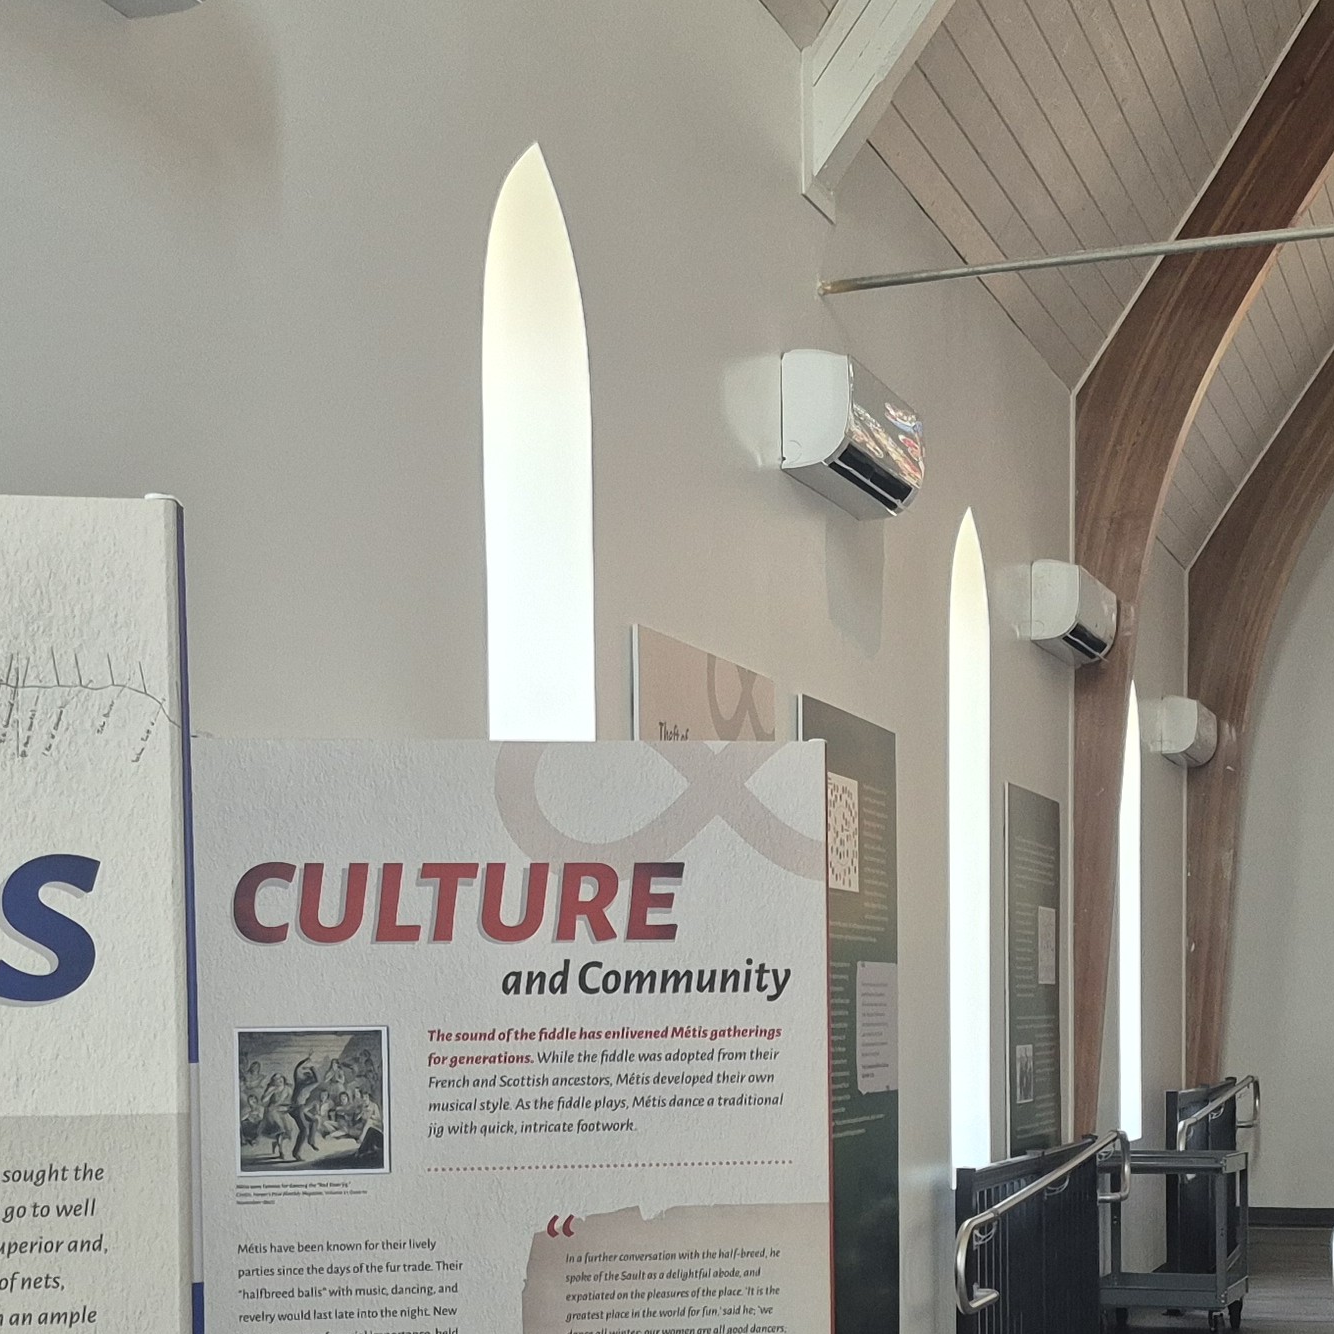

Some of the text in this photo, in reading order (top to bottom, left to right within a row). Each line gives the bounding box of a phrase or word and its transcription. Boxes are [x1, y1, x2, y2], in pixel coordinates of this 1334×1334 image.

[233, 861, 685, 945] CULTURE
[502, 957, 792, 1003] and Community
[427, 1024, 782, 1042] The sound of the fiddle has enlivened Métis gatherings
[427, 1051, 448, 1067] for
[536, 1049, 574, 1063] While
[577, 1049, 597, 1062] the
[600, 1048, 635, 1065] fiddle
[637, 1052, 662, 1062] was
[664, 1047, 714, 1064] adopted
[717, 1047, 746, 1062] from
[749, 1046, 779, 1060] their
[428, 1097, 477, 1111] musical
[514, 1097, 531, 1110] As
[533, 1096, 554, 1110] the
[556, 1095, 591, 1111] fiddle
[631, 1094, 666, 1108] Métis
[668, 1094, 704, 1107] dance
[706, 1097, 714, 1106] a
[717, 1092, 783, 1106] traditional
[1, 1162, 69, 1186] sought
[73, 1162, 104, 1181] the
[66, 1232, 107, 1254] and,
